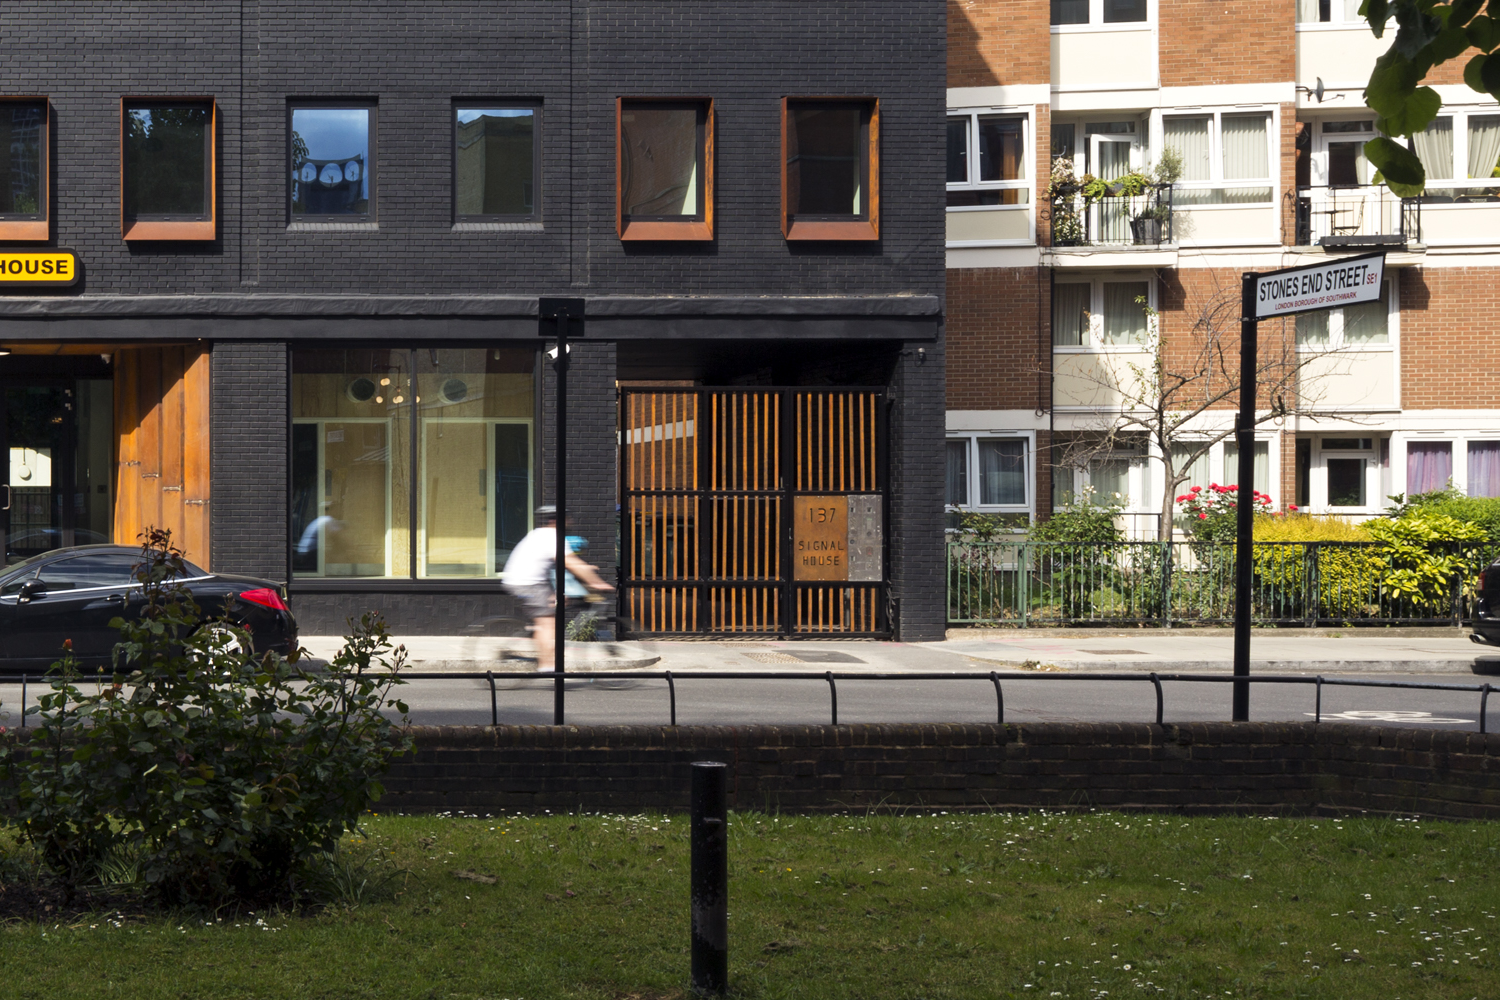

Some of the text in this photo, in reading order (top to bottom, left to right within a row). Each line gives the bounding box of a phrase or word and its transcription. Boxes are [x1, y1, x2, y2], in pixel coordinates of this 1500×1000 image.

[1259, 264, 1378, 302] STONES END STREET SE1
[1274, 291, 1357, 311] LONDON BOROUGH OF SOUTHWARK
[809, 507, 836, 523] 137
[798, 540, 844, 551] SIGNAL
[802, 555, 840, 566] HOUSE
